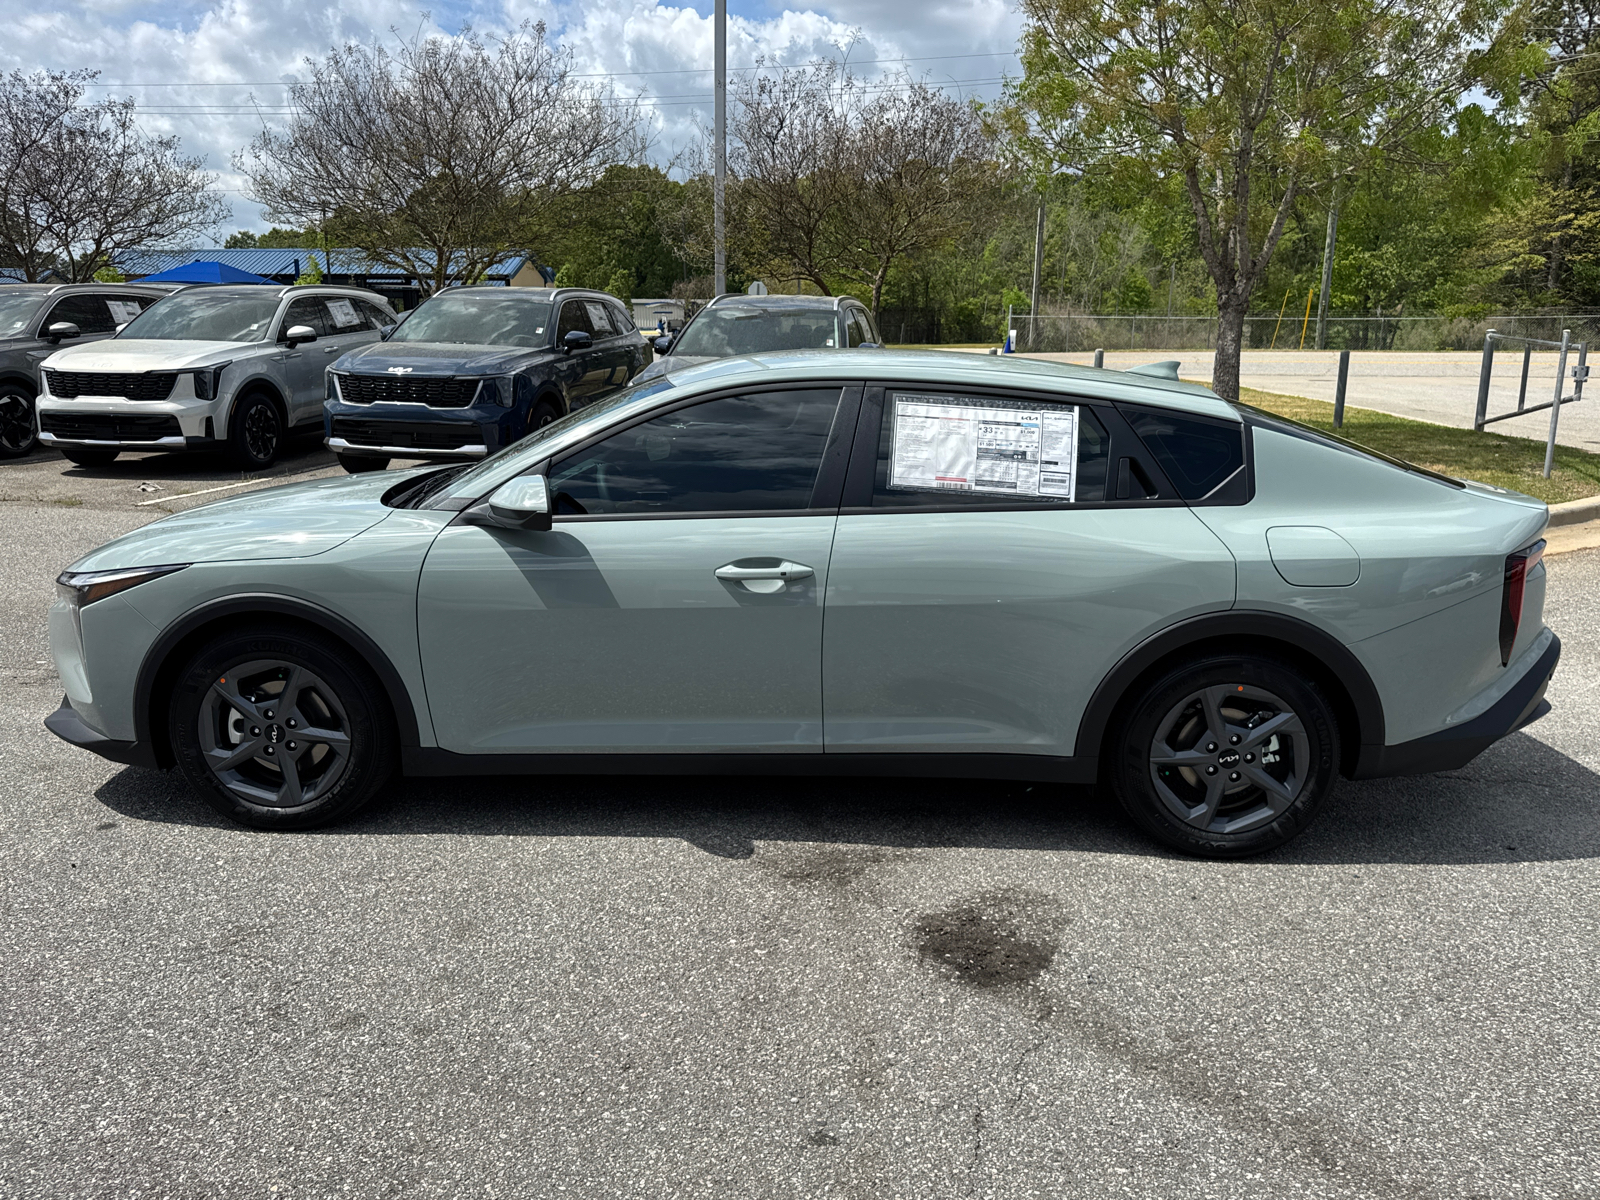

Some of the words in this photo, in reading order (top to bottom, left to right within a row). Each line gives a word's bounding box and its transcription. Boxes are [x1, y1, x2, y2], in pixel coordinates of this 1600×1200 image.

[983, 426, 993, 434] 33
[246, 640, 309, 658] KUMHO
[1310, 708, 1331, 768] KUMHO
[1218, 753, 1239, 763] KIA
